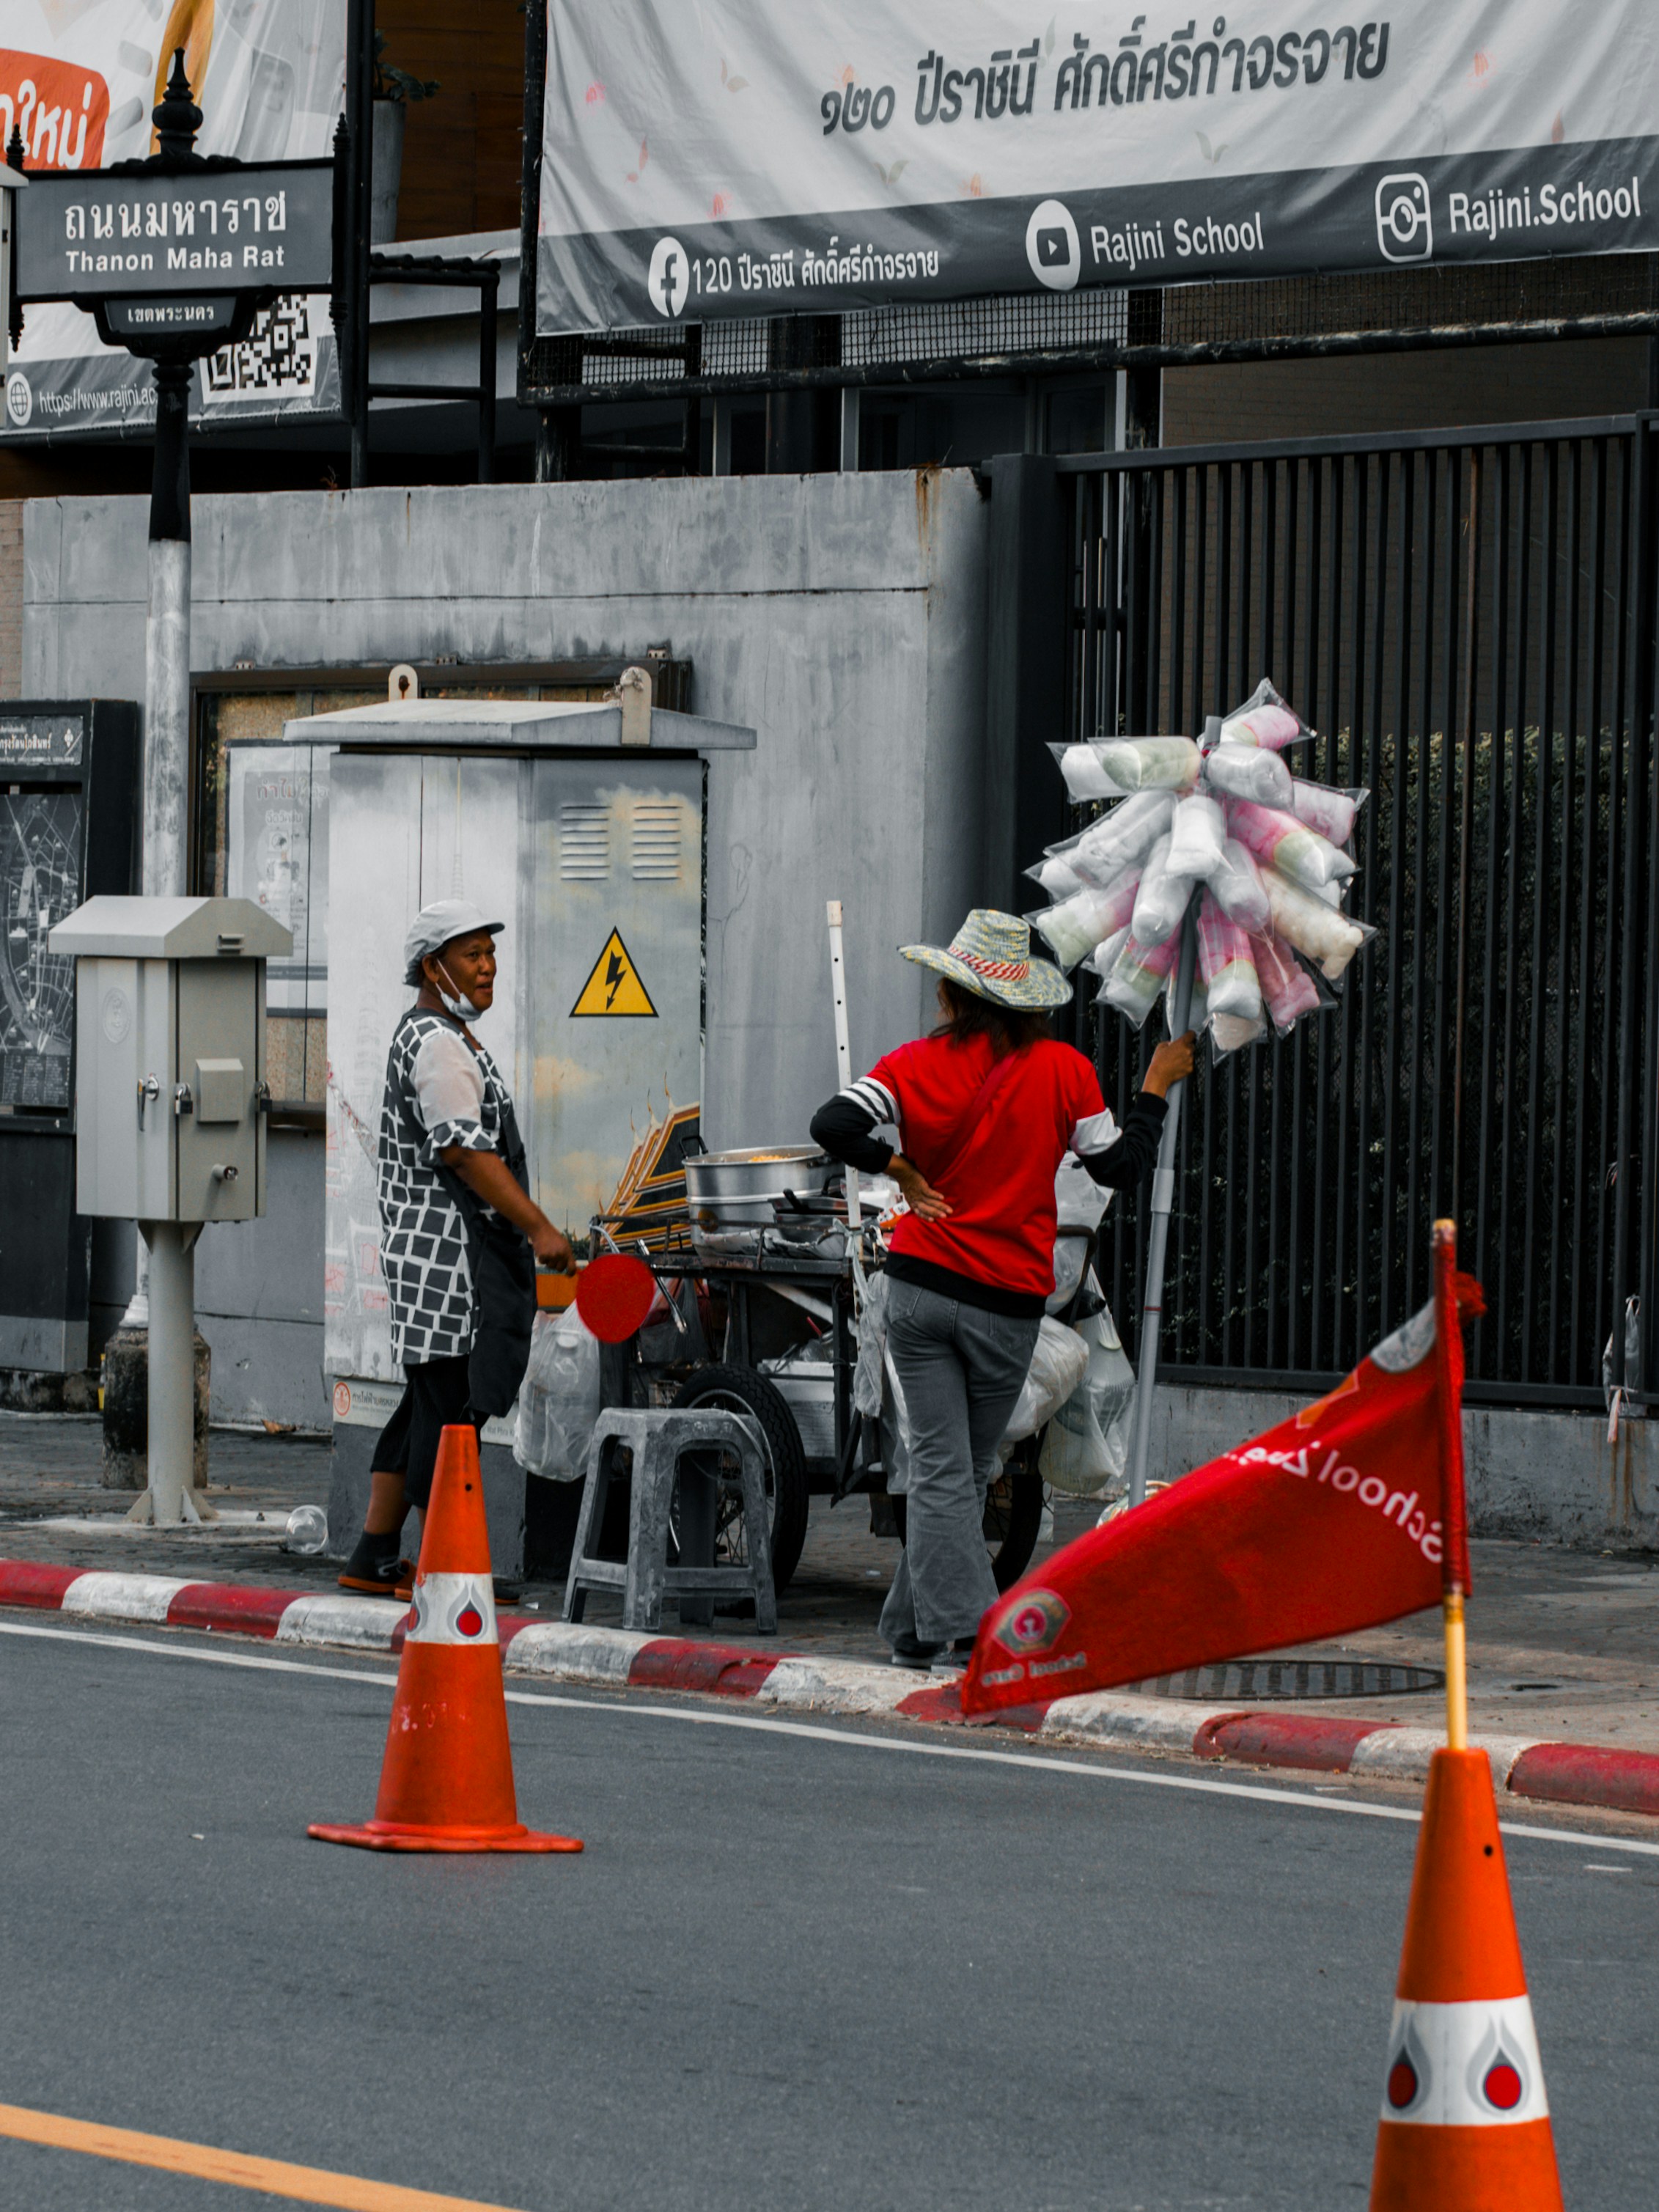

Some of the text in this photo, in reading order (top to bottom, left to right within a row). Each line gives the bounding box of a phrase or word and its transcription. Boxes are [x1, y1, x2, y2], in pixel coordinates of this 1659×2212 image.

[820, 15, 1391, 136] ๑๒๐ ปีราชินี ศักดิ์ศรีกำจรจาย
[65, 191, 286, 240] ถนนมหาราช
[1449, 176, 1641, 241] Rajini.School
[65, 246, 284, 272] Thanon Maha Rat
[693, 257, 732, 294] 120
[737, 249, 795, 290] ปีราชินี
[802, 236, 939, 285] ศักดิ์ศรีกำจรจาย
[1090, 212, 1264, 271] Rajini School
[128, 306, 215, 323] เขตพระนคร
